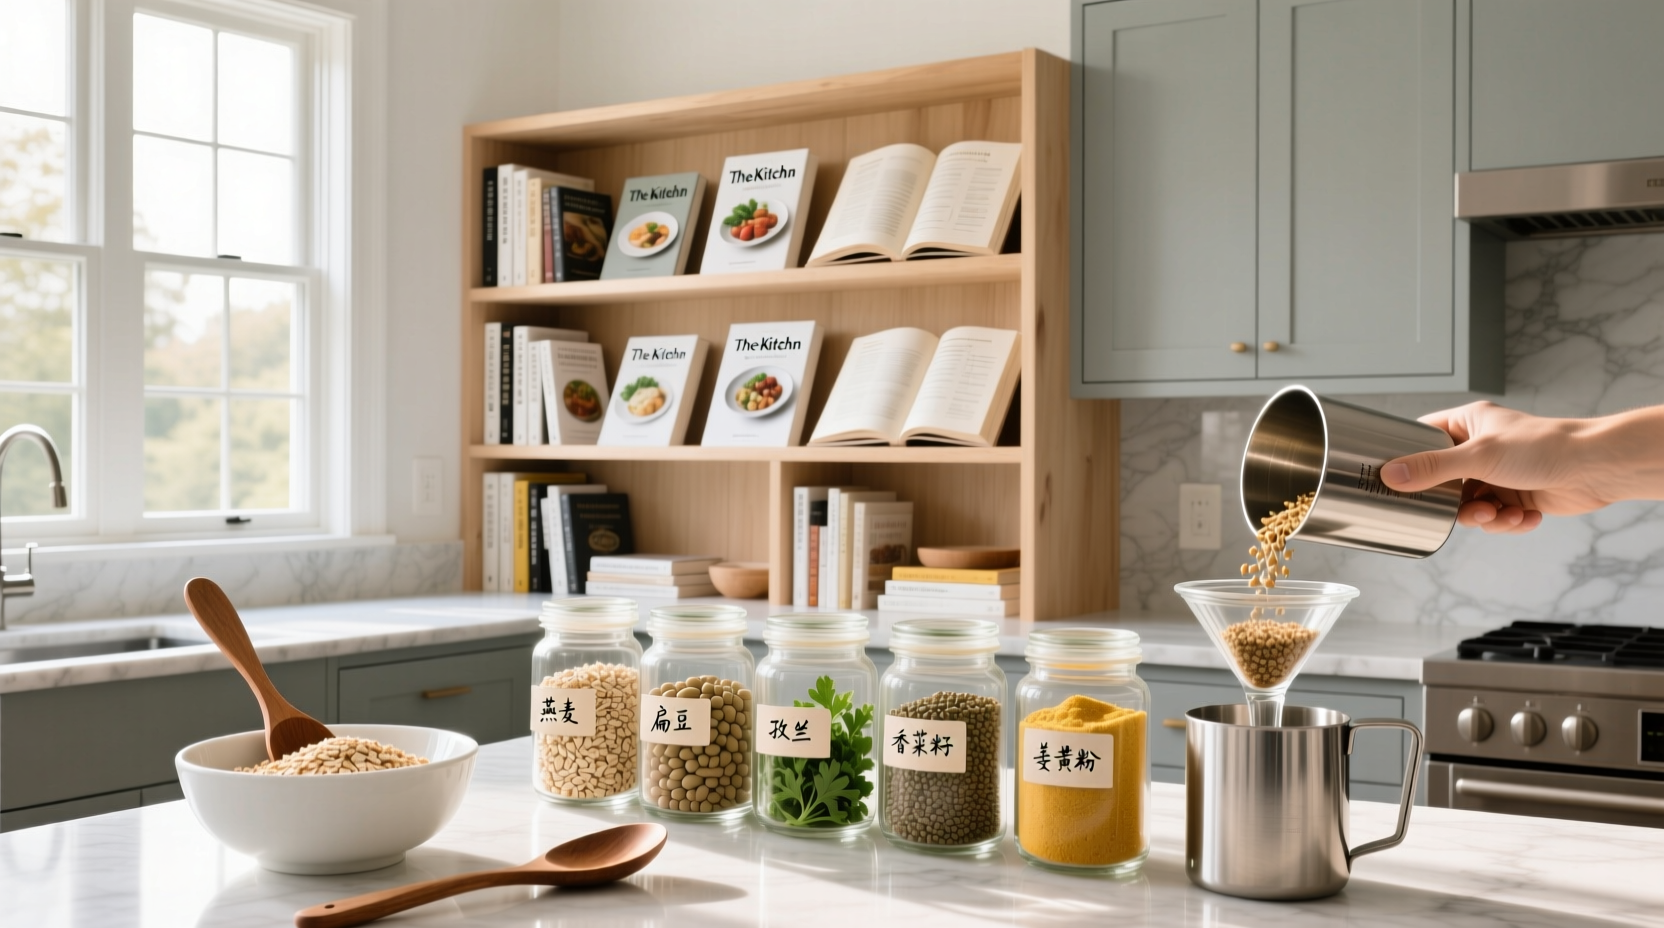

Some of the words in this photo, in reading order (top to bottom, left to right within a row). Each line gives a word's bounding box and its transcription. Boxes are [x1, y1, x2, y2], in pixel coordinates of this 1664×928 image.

[540, 696, 579, 725] 燕麦
[650, 704, 692, 733] 扁豆
[891, 728, 954, 758] 香菜籽
[1033, 741, 1102, 773] 姜黄粉
